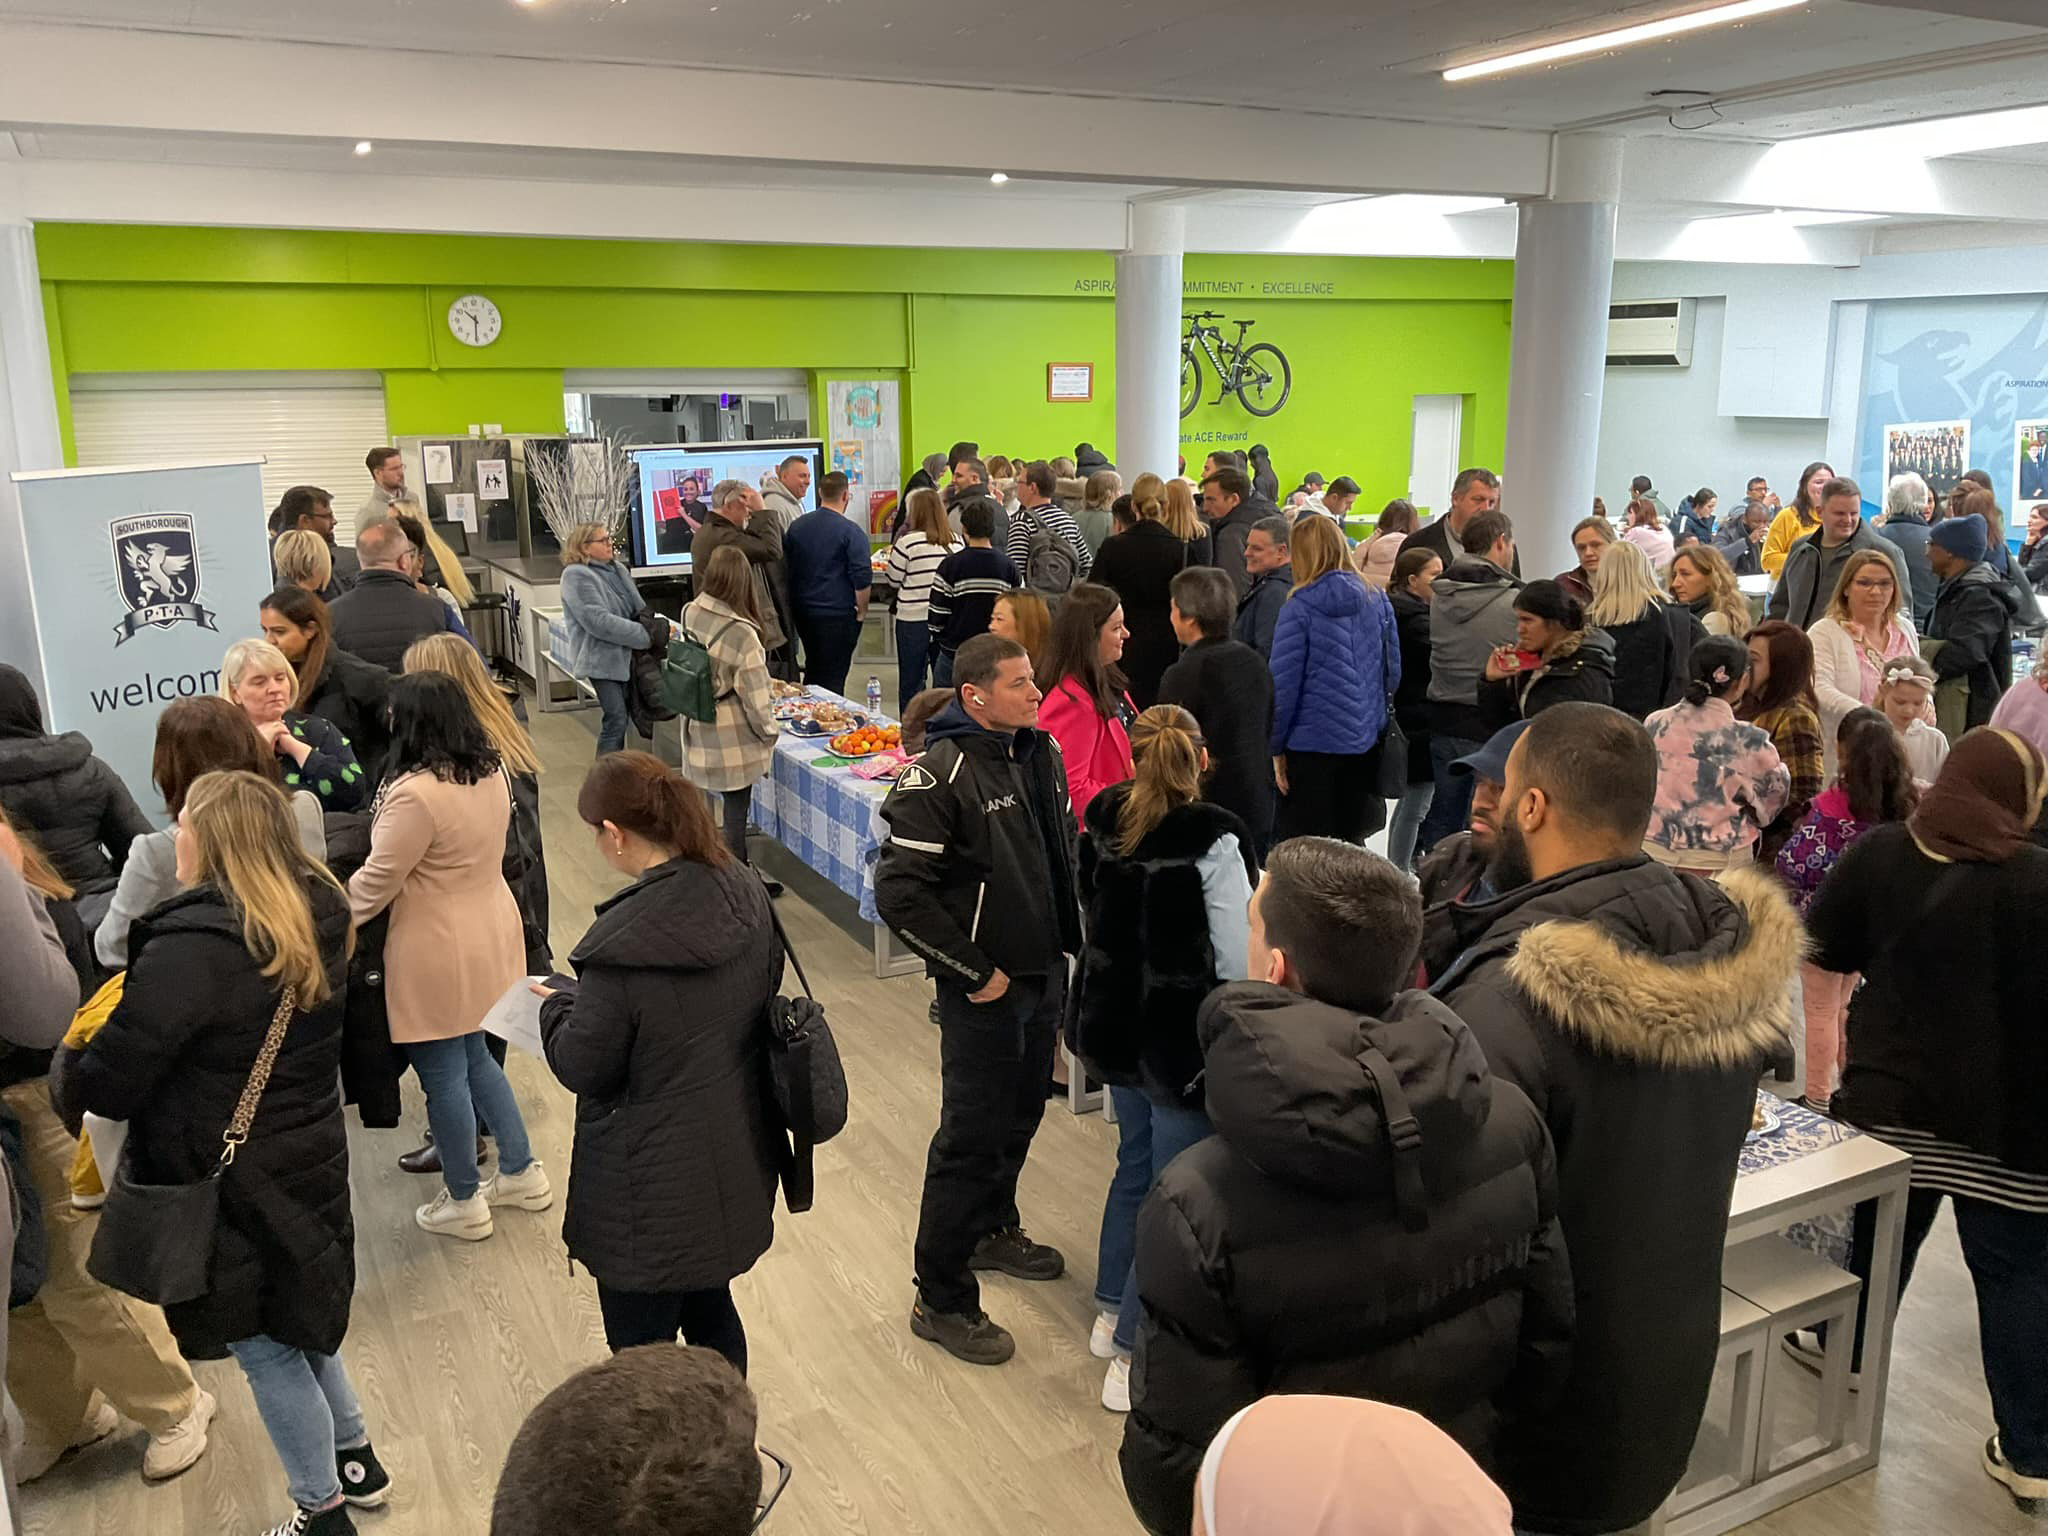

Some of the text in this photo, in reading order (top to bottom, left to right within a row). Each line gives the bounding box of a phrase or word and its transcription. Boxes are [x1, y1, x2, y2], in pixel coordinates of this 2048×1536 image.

[1074, 279, 1334, 294] ASPIRA MMITMENT EXCELLENCE
[1194, 431, 1213, 442] ACE
[1215, 431, 1248, 441] Reward
[116, 518, 188, 536] SOUTHBOROUGH
[90, 669, 221, 713] welcom
